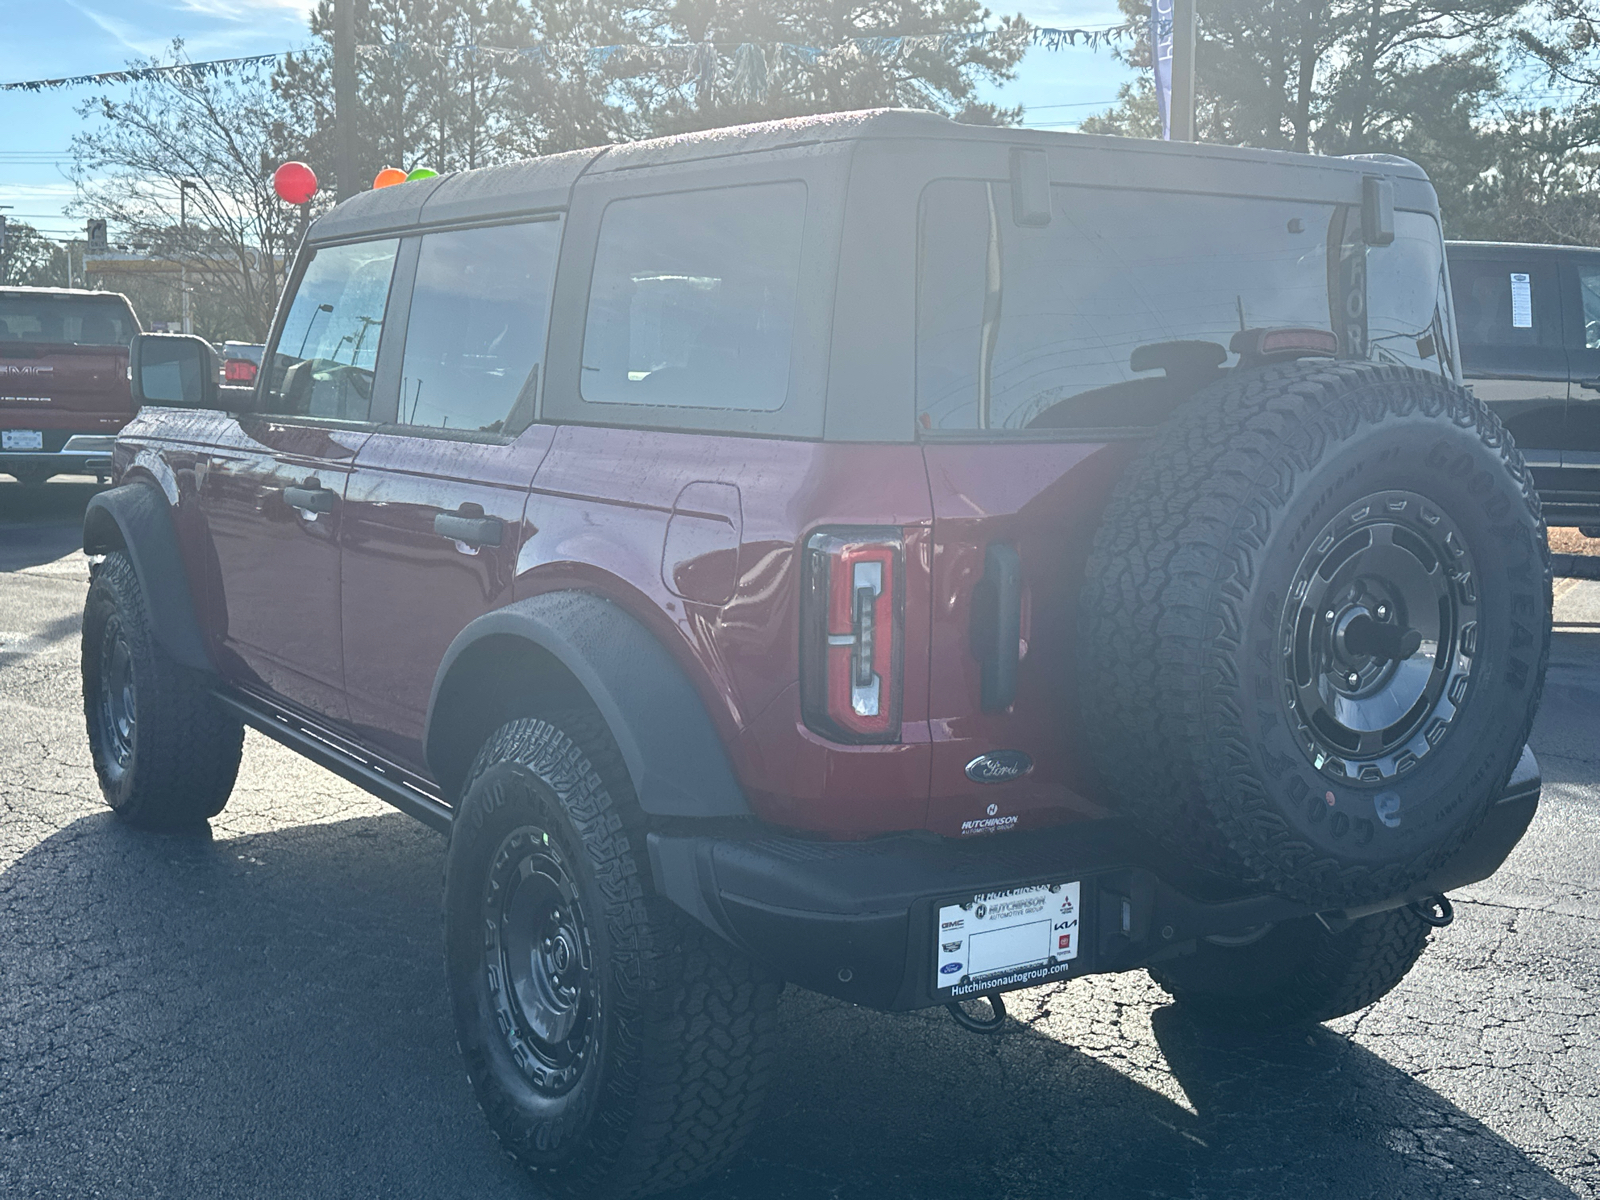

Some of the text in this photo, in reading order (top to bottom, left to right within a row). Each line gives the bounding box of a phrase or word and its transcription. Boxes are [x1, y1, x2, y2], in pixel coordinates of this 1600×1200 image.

[1424, 440, 1536, 692] GOODYEAR
[980, 759, 1019, 777] Ford
[961, 815, 1019, 830] HUTCHINSON
[988, 895, 1046, 915] HUTCHINSON
[989, 904, 1044, 921] AUTOMOTIVE GROUP
[941, 919, 965, 929] GMC
[951, 962, 1069, 997] Hutchinsonautogroup.com
